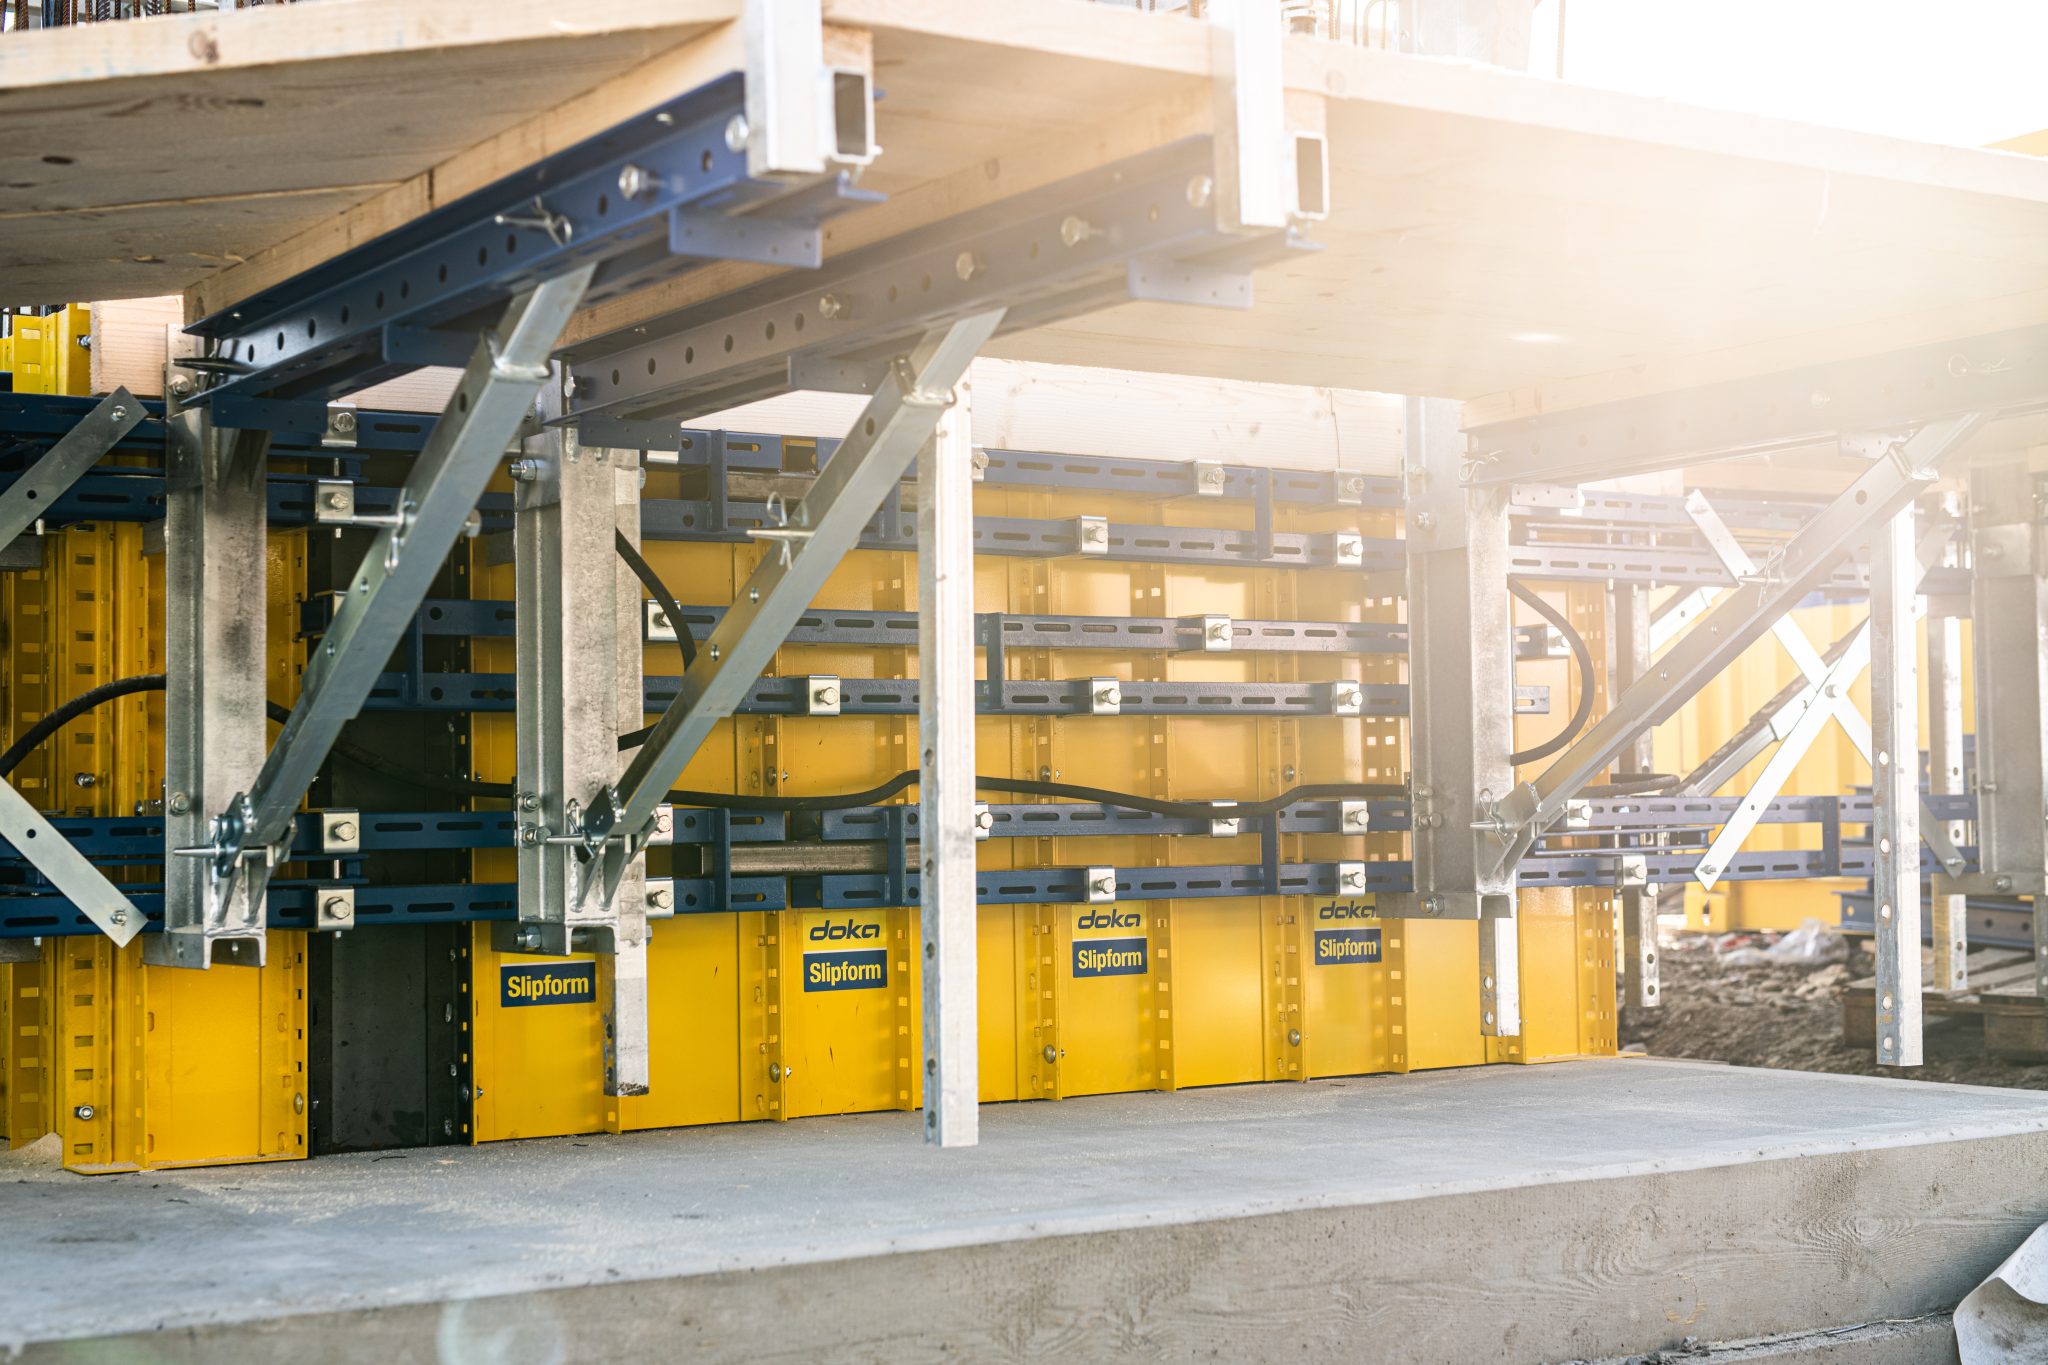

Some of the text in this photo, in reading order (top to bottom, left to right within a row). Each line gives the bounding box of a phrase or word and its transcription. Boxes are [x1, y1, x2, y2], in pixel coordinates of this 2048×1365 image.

[809, 919, 880, 941] doka
[1077, 909, 1141, 930] doka
[1077, 948, 1142, 973] Slipform
[1319, 938, 1377, 961] Slipform
[809, 961, 882, 987] Slipform
[507, 974, 589, 1001] Slipform
